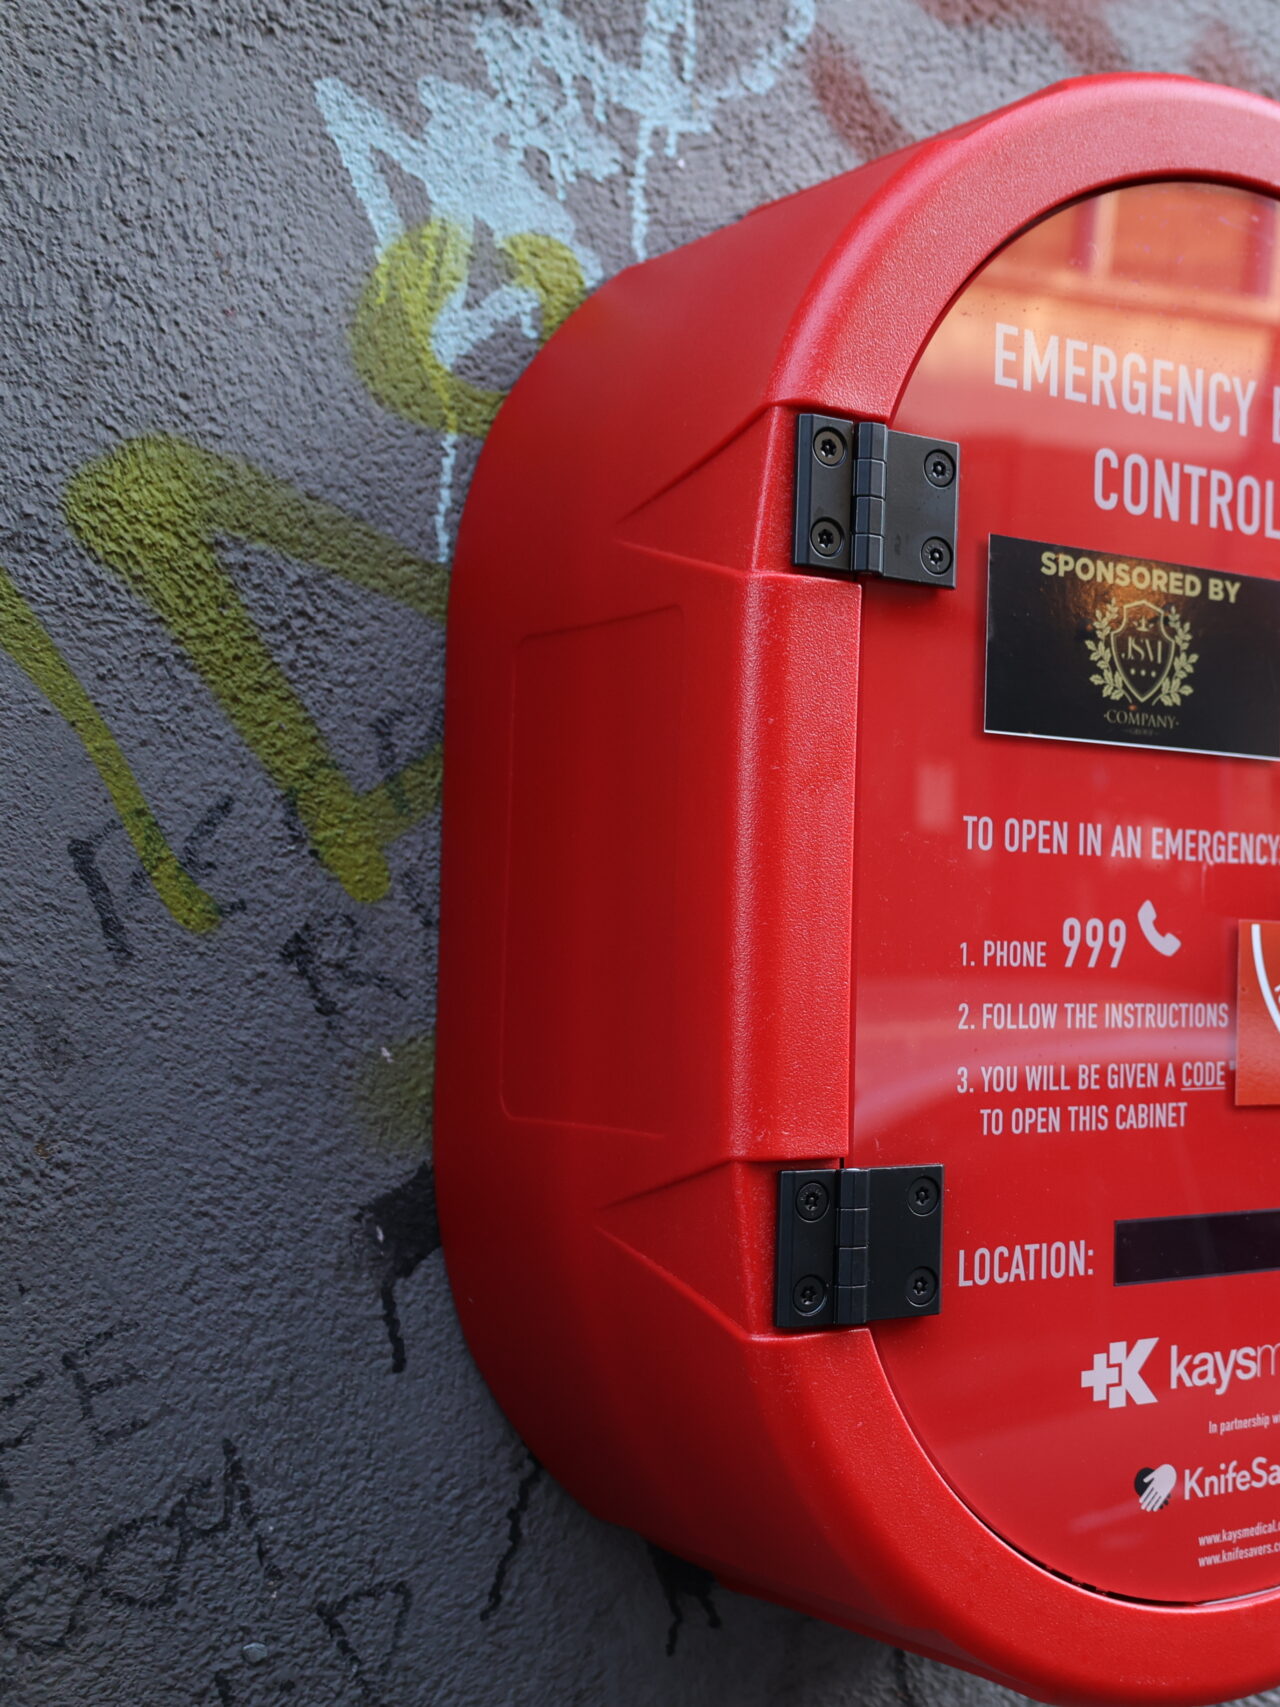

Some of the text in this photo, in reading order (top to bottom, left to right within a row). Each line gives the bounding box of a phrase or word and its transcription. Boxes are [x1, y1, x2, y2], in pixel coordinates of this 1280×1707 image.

[994, 322, 1257, 438] EMERGENCY
[1040, 551, 1241, 604] SPONSORED BY
[963, 815, 993, 851] TO
[1004, 817, 1068, 855] OPEN
[1078, 822, 1102, 857] IN
[1111, 824, 1142, 859] AN
[960, 917, 1127, 969] 1. PHONE 999
[958, 1002, 1229, 1030] 2. FOLLOW THE INSTRUCTIONS
[957, 1061, 1226, 1094] 3. YOU WILL BE GIVEN A CODE
[980, 1102, 1188, 1136] TO OPEN THIS CABINET
[958, 1239, 1094, 1287] LOCATION:
[1208, 1420, 1218, 1434] In
[1219, 1413, 1270, 1436] partnership
